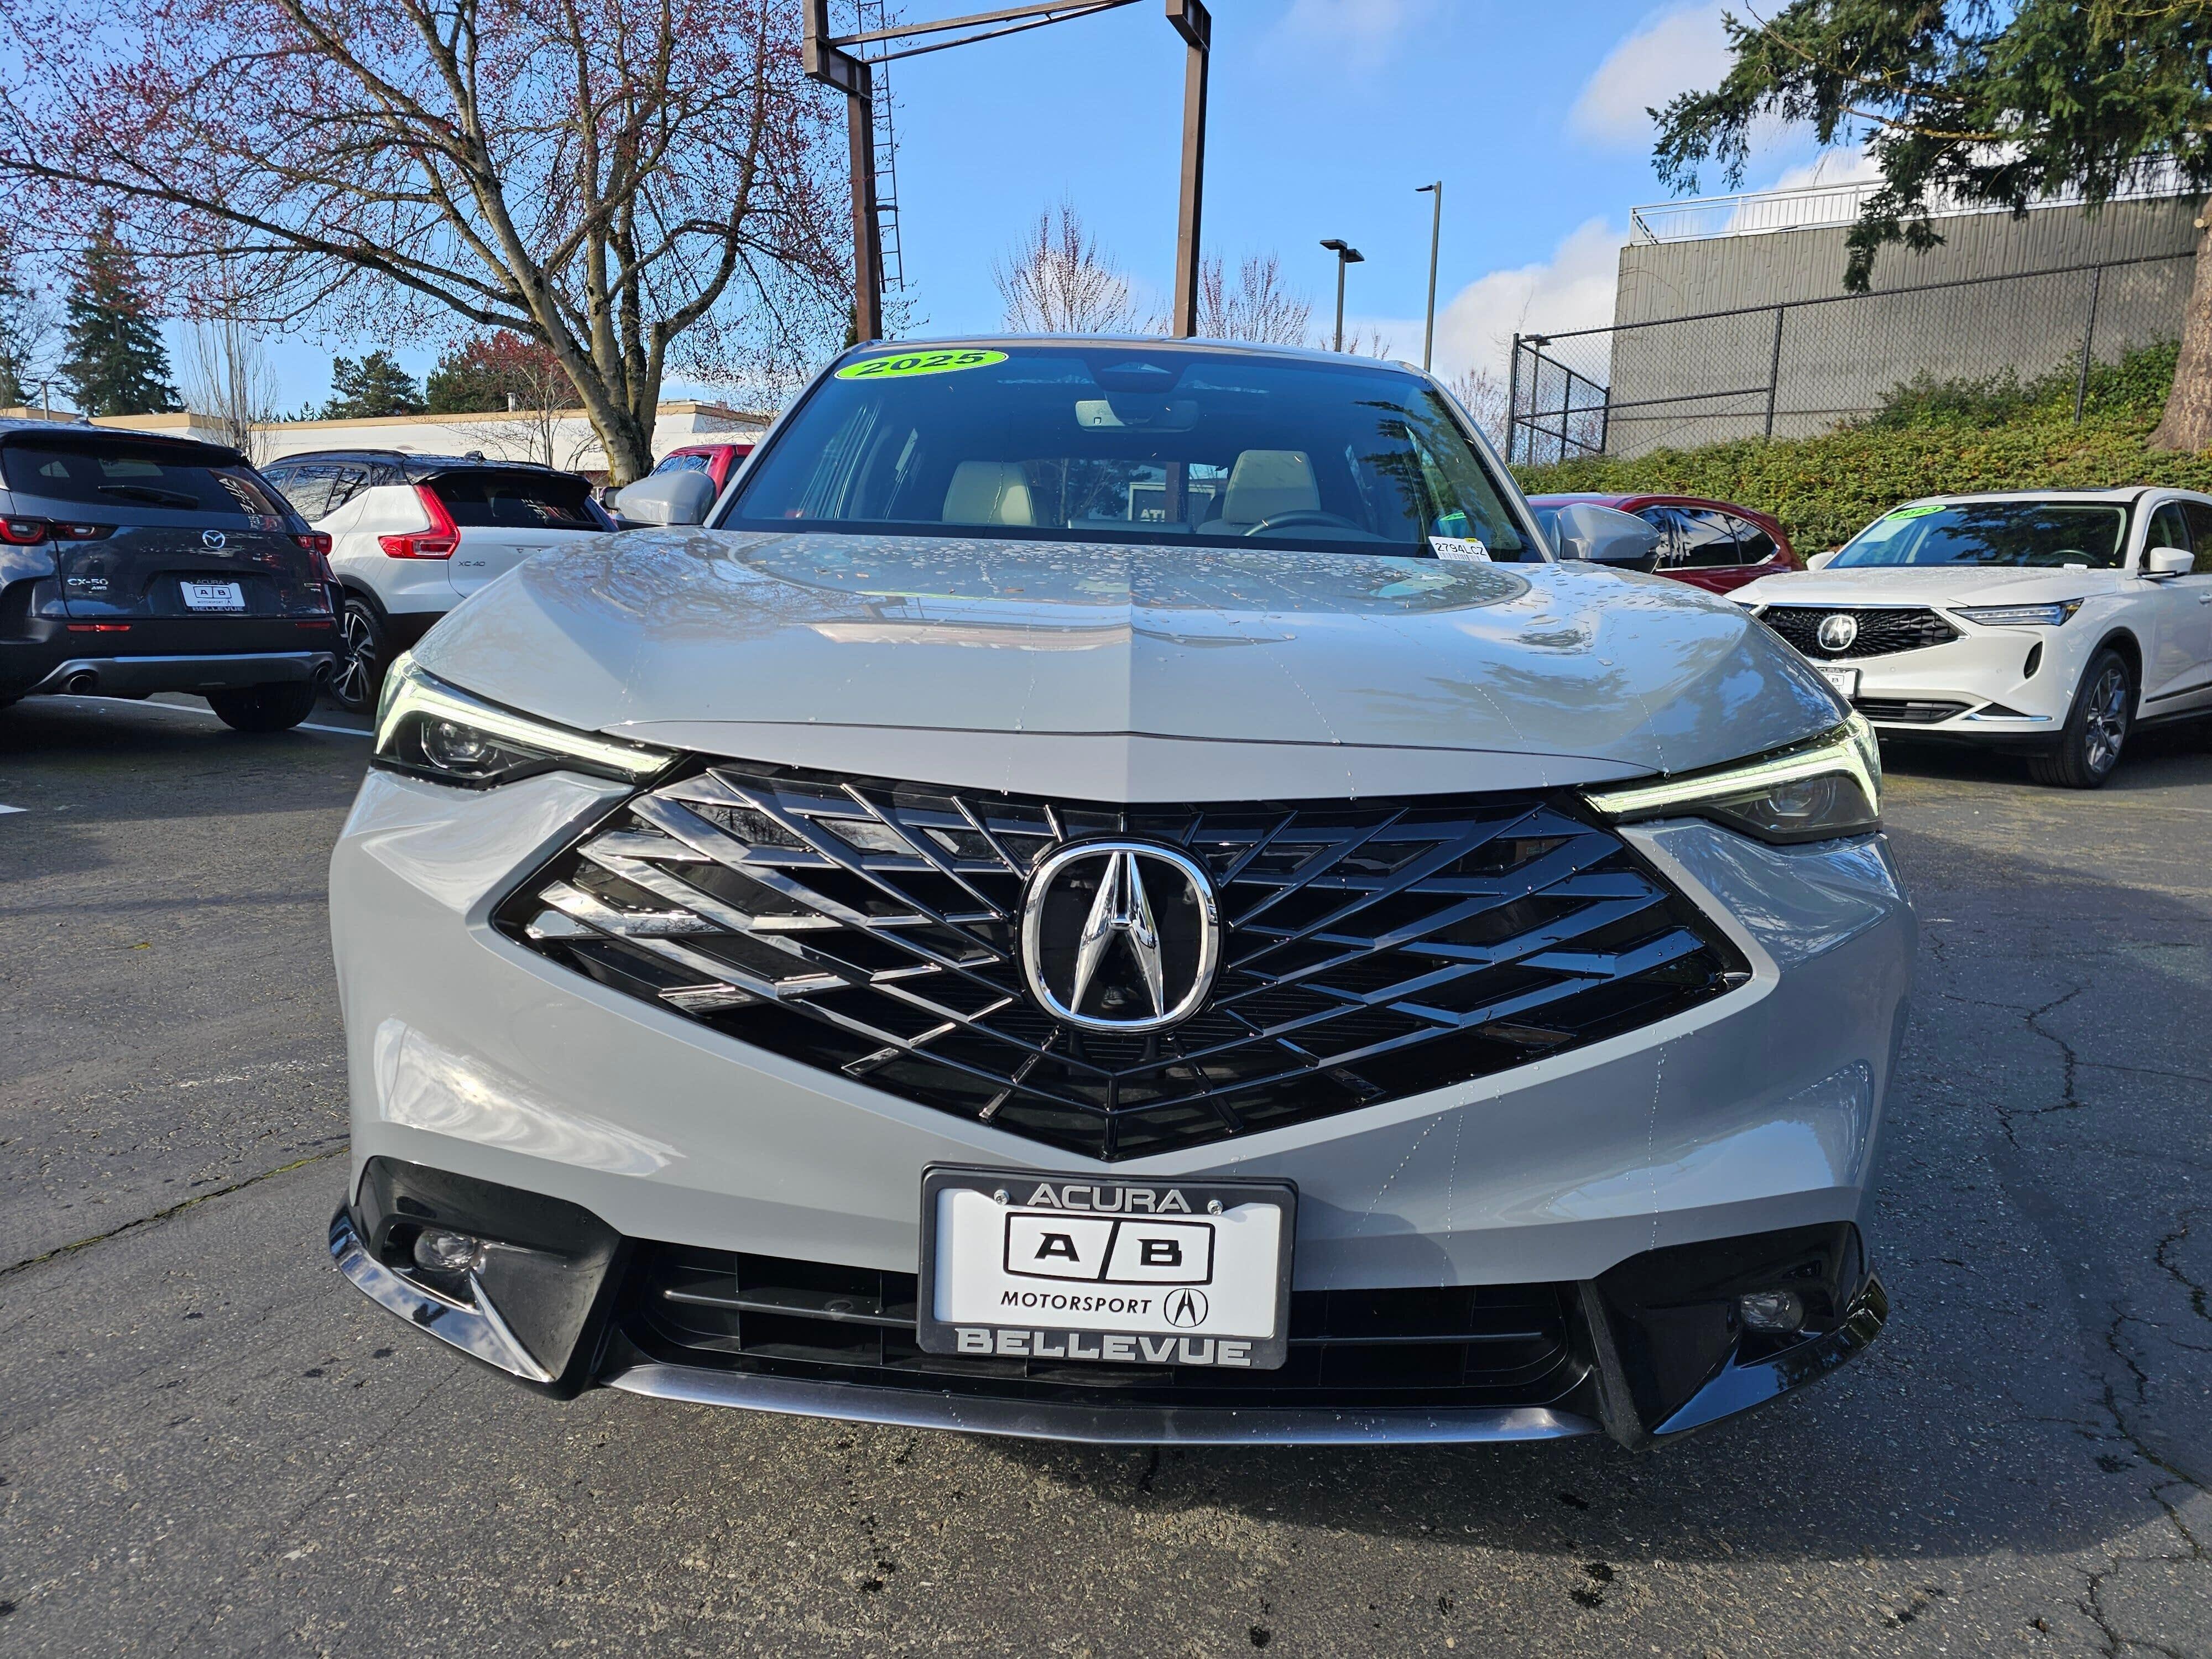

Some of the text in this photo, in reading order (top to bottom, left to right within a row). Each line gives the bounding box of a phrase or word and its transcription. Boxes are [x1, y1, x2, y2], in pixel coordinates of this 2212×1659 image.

[854, 352, 988, 377] 2025
[1027, 1183, 1192, 1213] ACURA
[1034, 1232, 1182, 1267] A B
[1000, 1290, 1152, 1314] MOTORSPORT
[955, 1327, 1253, 1366] BELLEVUE
